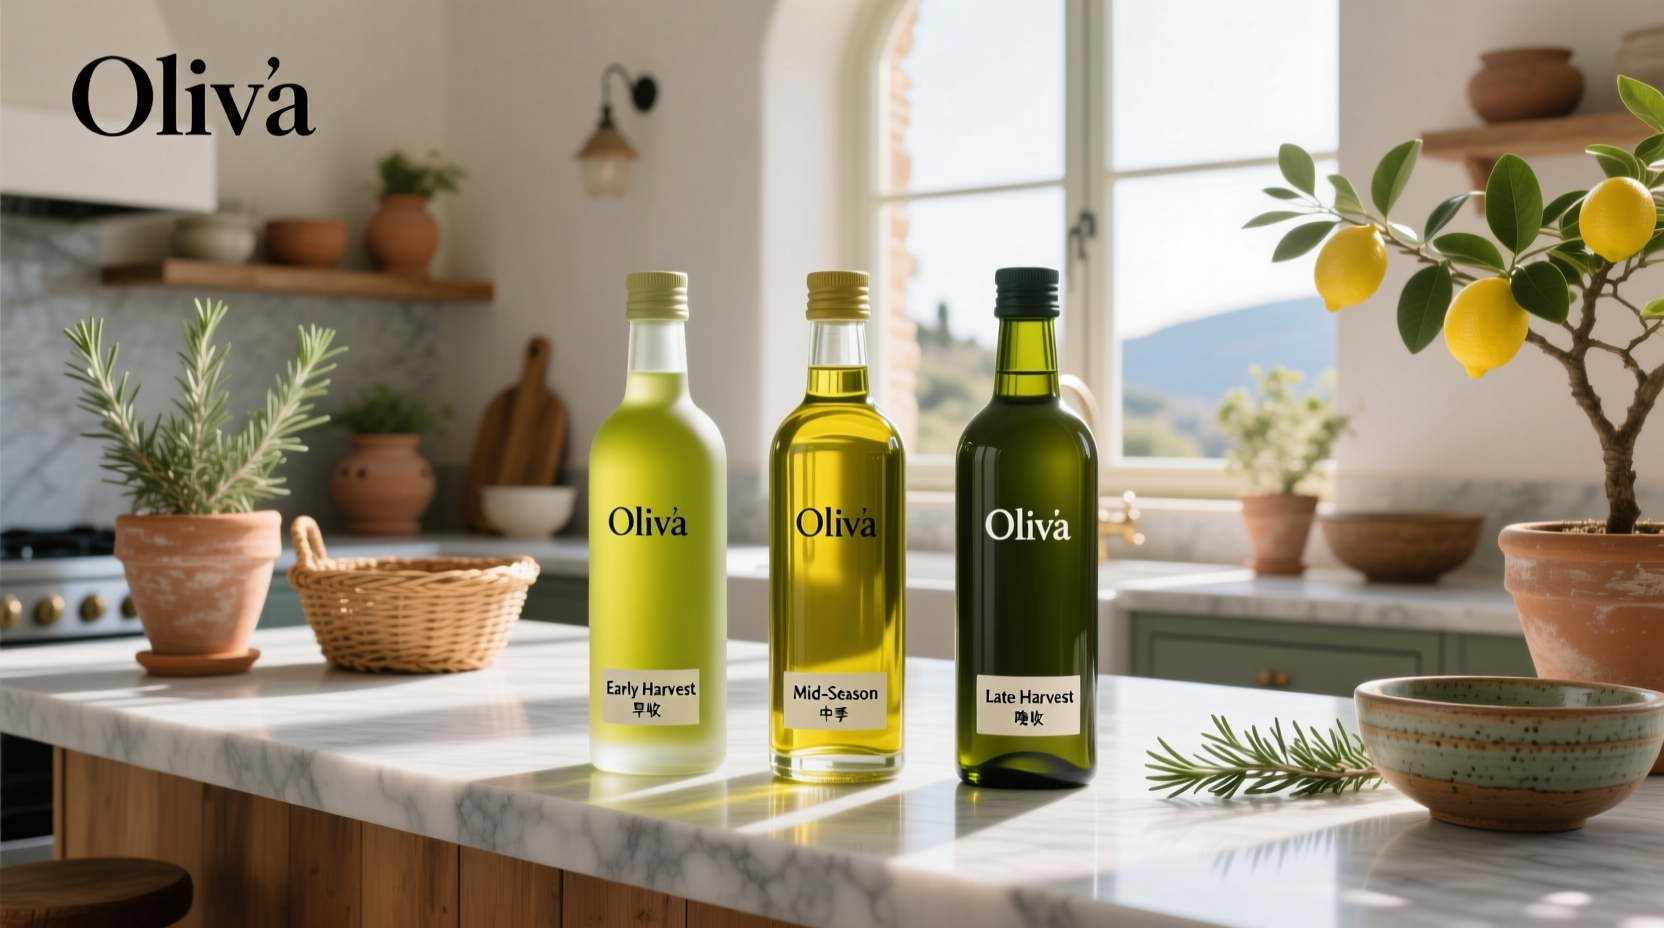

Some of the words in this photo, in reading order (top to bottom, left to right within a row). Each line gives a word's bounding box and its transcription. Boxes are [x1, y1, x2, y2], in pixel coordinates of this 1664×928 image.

[606, 680, 639, 699] Early
[642, 681, 697, 696] Harvest
[793, 684, 878, 700] Mid-Season
[985, 689, 1016, 704] Late
[1020, 689, 1074, 704] Harvest
